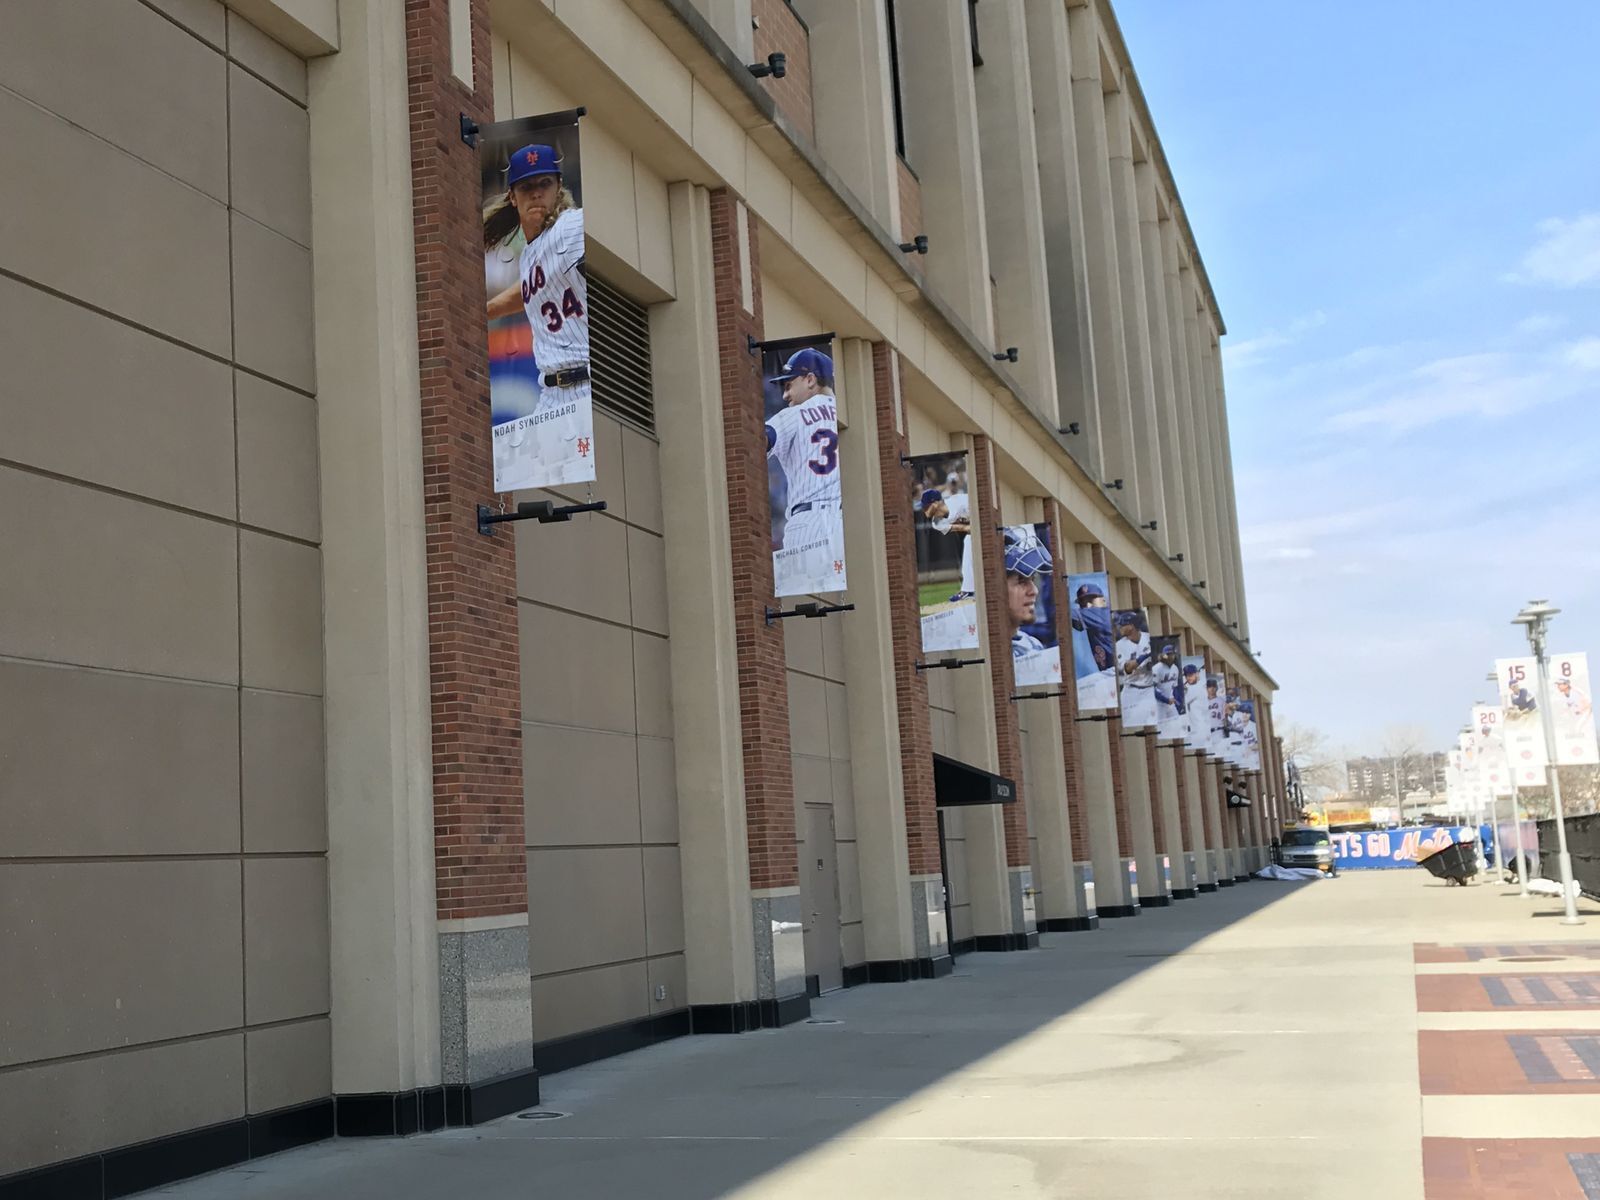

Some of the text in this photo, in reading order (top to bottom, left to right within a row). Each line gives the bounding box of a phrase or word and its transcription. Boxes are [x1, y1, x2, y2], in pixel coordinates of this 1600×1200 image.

[541, 286, 585, 333] 34
[494, 403, 577, 438] NOAH SYNDERGAARD
[808, 428, 838, 475] 3
[775, 548, 799, 560] MICHAEL
[1508, 665, 1526, 681] 15
[1561, 661, 1572, 677] 8
[1480, 712, 1496, 724] 20
[1330, 827, 1454, 862] ET'S GO Mets
